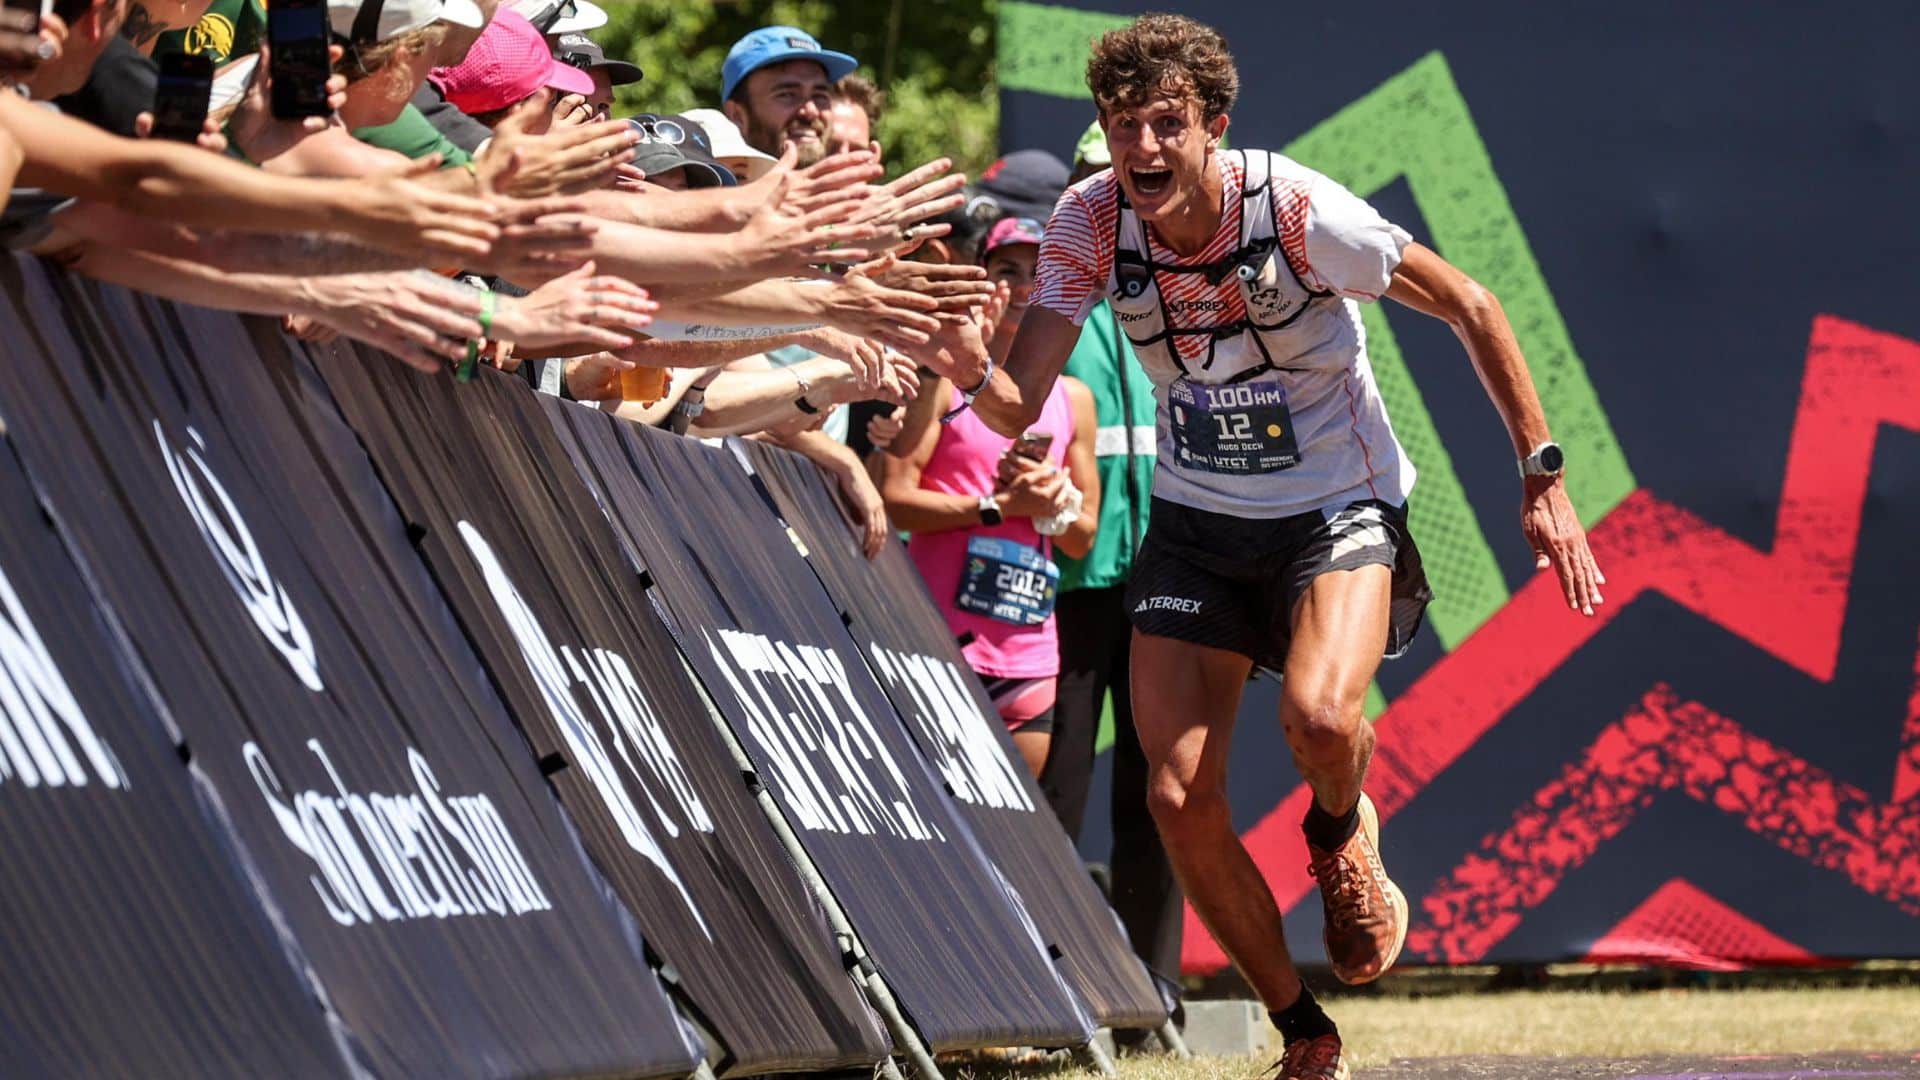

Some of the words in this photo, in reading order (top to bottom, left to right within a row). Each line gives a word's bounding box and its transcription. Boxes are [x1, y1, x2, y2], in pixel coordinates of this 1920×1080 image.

[1178, 300, 1230, 312] TERREX
[1213, 413, 1253, 440] 12
[1213, 456, 1249, 466] UTCT
[995, 563, 1047, 600] 2012
[1149, 596, 1202, 614] TERREX
